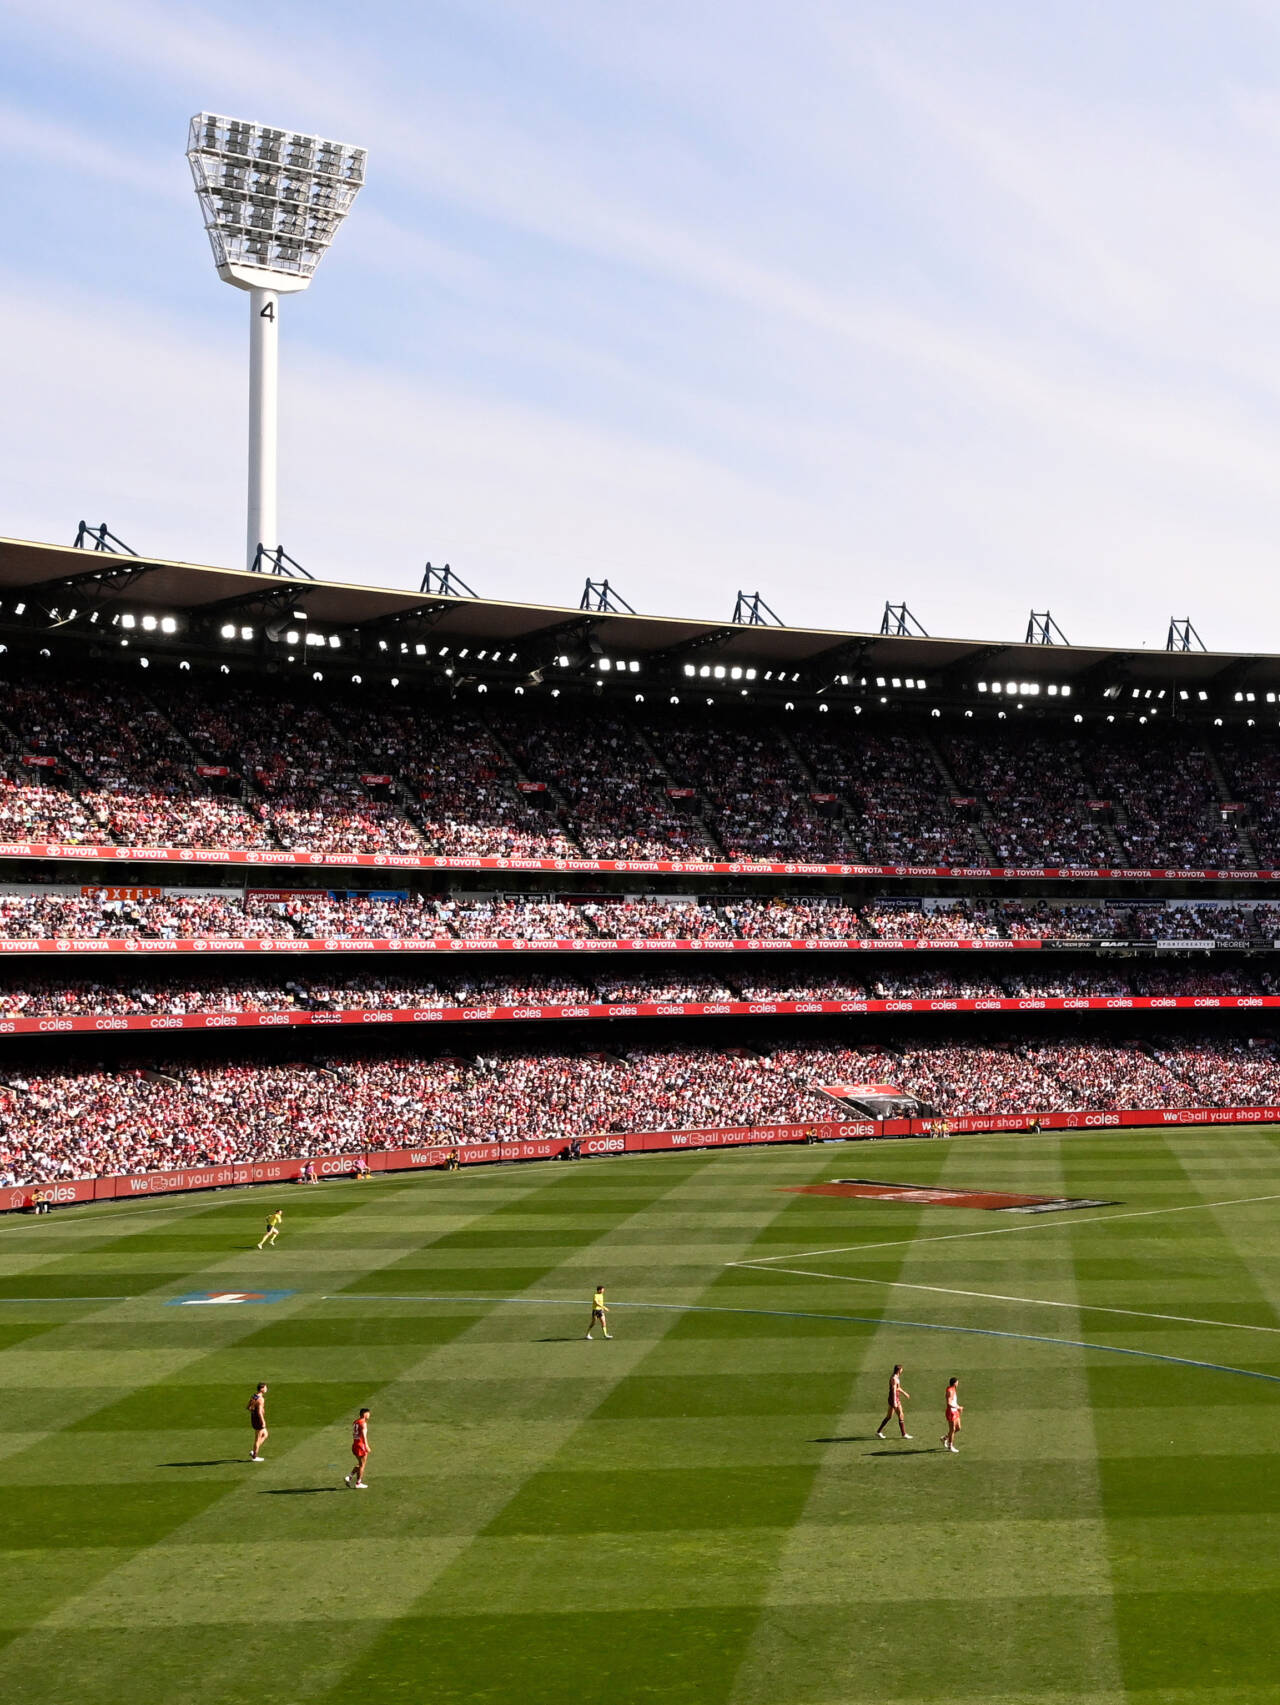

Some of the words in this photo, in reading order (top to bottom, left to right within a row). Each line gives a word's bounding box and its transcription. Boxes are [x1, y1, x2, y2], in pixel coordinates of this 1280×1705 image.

[260, 301, 275, 323] 4
[63, 848, 98, 857] TOYOTA
[194, 851, 229, 860] TOYOTA
[325, 855, 358, 864] TOYOTA
[569, 862, 600, 870] TOYOTA
[799, 865, 827, 873] TOYOTA
[74, 941, 109, 950] TOYOTA
[275, 941, 309, 949] TOYOTA
[466, 940, 498, 949] TOYOTA
[646, 940, 677, 949] TOYOTA
[874, 940, 903, 948] TOYOTA
[39, 1018, 73, 1031] coles
[150, 1016, 183, 1028] coles
[259, 1013, 289, 1025] coles
[363, 1011, 393, 1023] coles
[513, 1008, 541, 1019] coles
[657, 1004, 684, 1015] coles
[796, 1002, 822, 1013] coles
[931, 1000, 957, 1010] coles
[1064, 999, 1089, 1008] coles
[971, 1117, 994, 1130] your
[996, 1115, 1023, 1129] shop
[1085, 1112, 1120, 1126] coles
[1210, 1109, 1234, 1122] your
[1236, 1108, 1262, 1122] shop
[1264, 1108, 1275, 1119] to
[721, 1130, 746, 1144] your
[747, 1128, 774, 1142] shop
[777, 1128, 789, 1140] to
[791, 1128, 804, 1138] us
[839, 1122, 875, 1137] coles
[588, 1136, 625, 1152] coles
[463, 1147, 490, 1163] your
[491, 1144, 520, 1160] shop
[522, 1142, 535, 1156] to
[537, 1145, 551, 1155] us
[187, 1172, 215, 1189] your
[217, 1166, 248, 1184] shop
[252, 1165, 264, 1178] to
[266, 1165, 281, 1178] us
